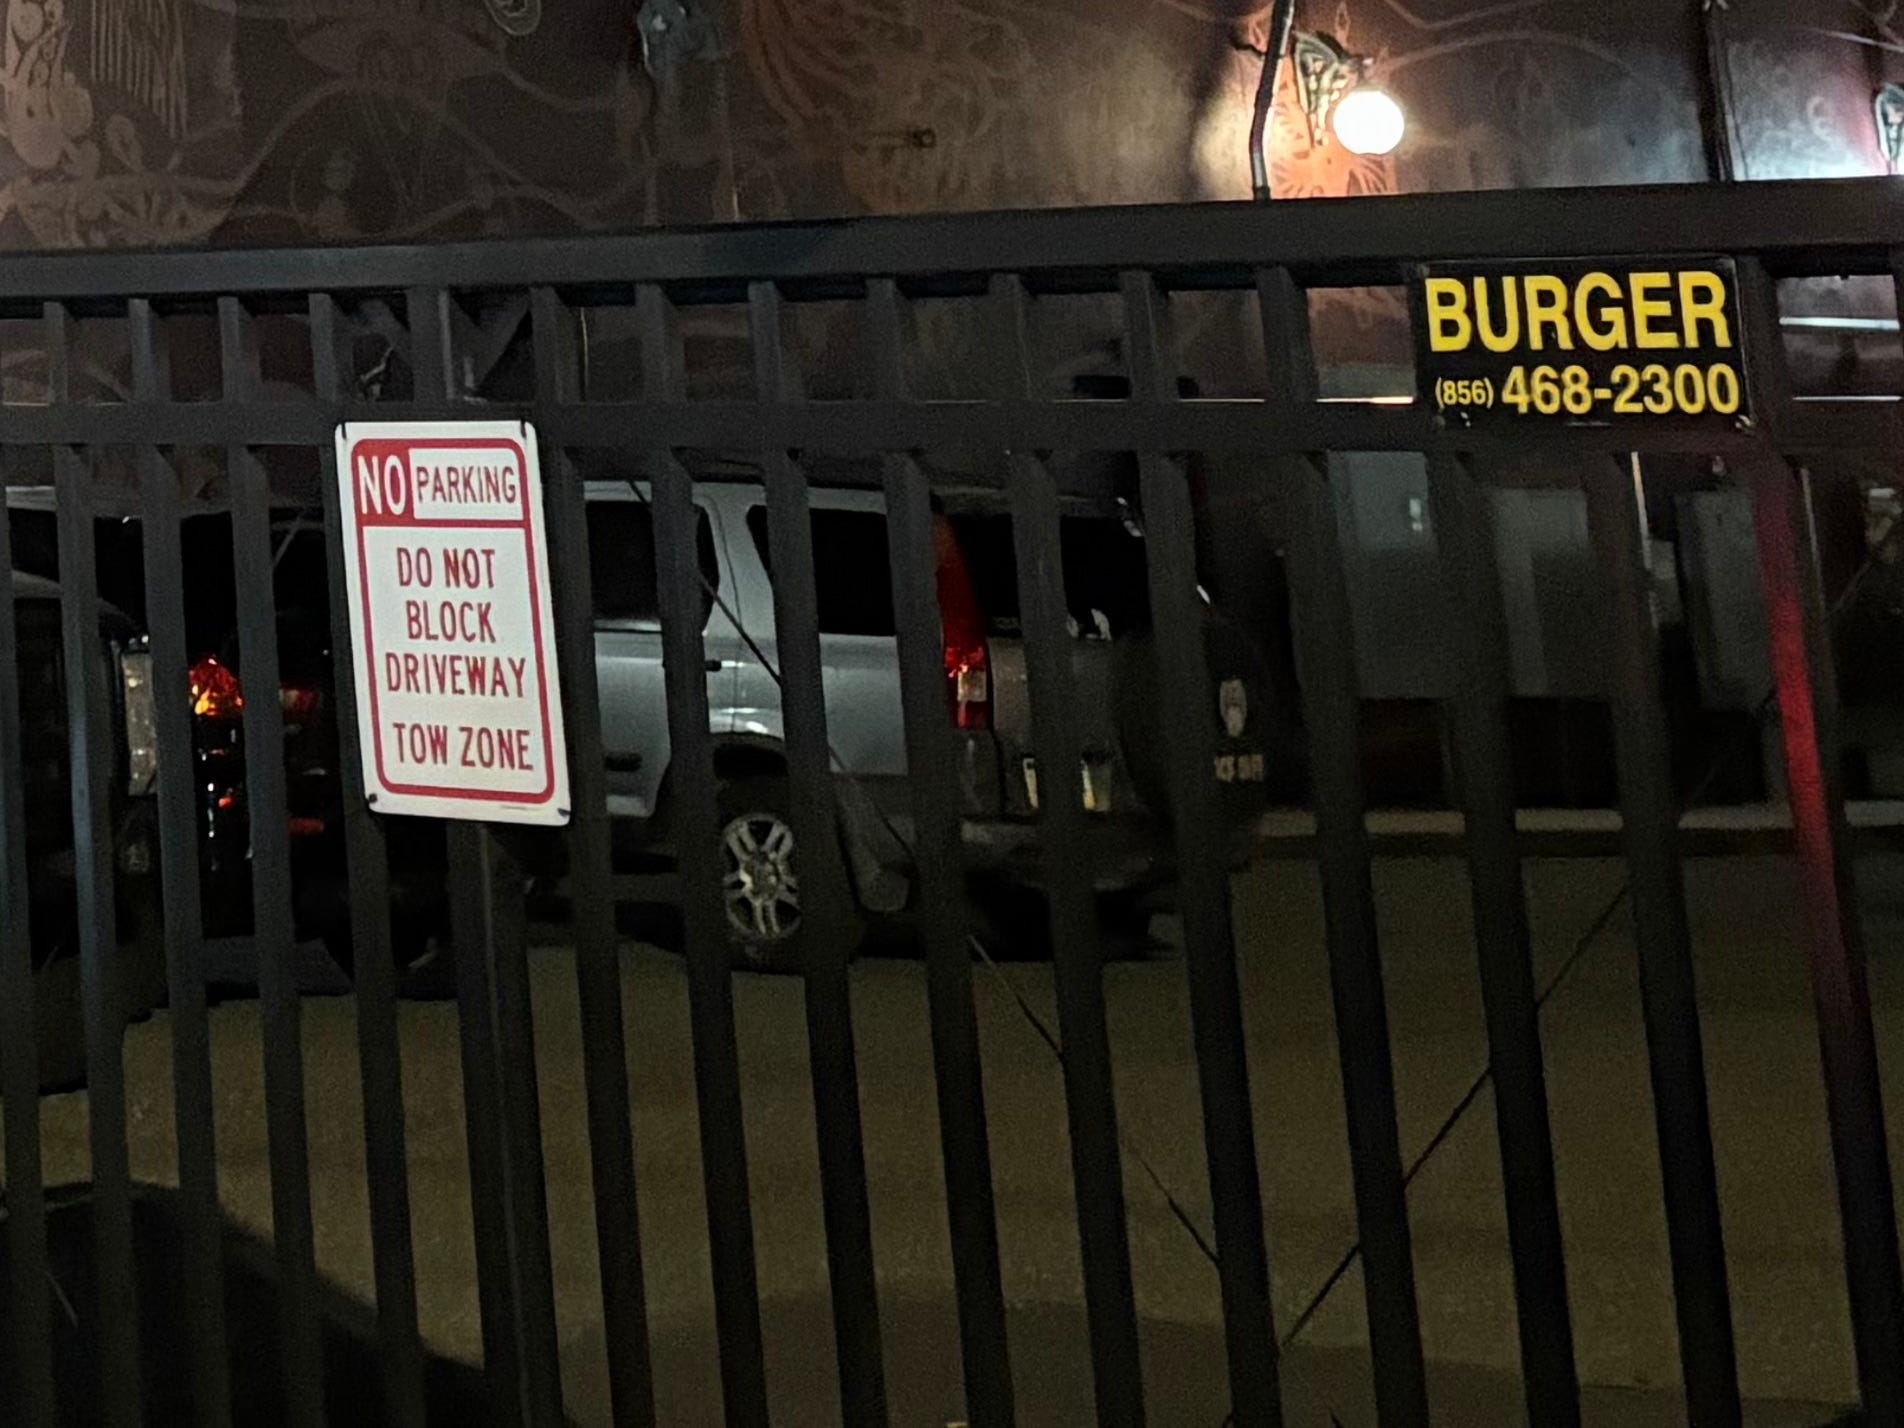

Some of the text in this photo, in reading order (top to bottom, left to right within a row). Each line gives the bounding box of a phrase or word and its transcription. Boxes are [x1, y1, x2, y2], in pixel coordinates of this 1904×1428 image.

[1424, 270, 1733, 352] BURGER
[1434, 363, 1740, 415] (856) 468-2300
[357, 454, 517, 515] NO PARKING
[396, 547, 496, 590] DO NOT
[405, 600, 497, 644] BLOCK
[385, 652, 527, 698] DRIVEWAY
[392, 722, 534, 771] TOW ZONE
